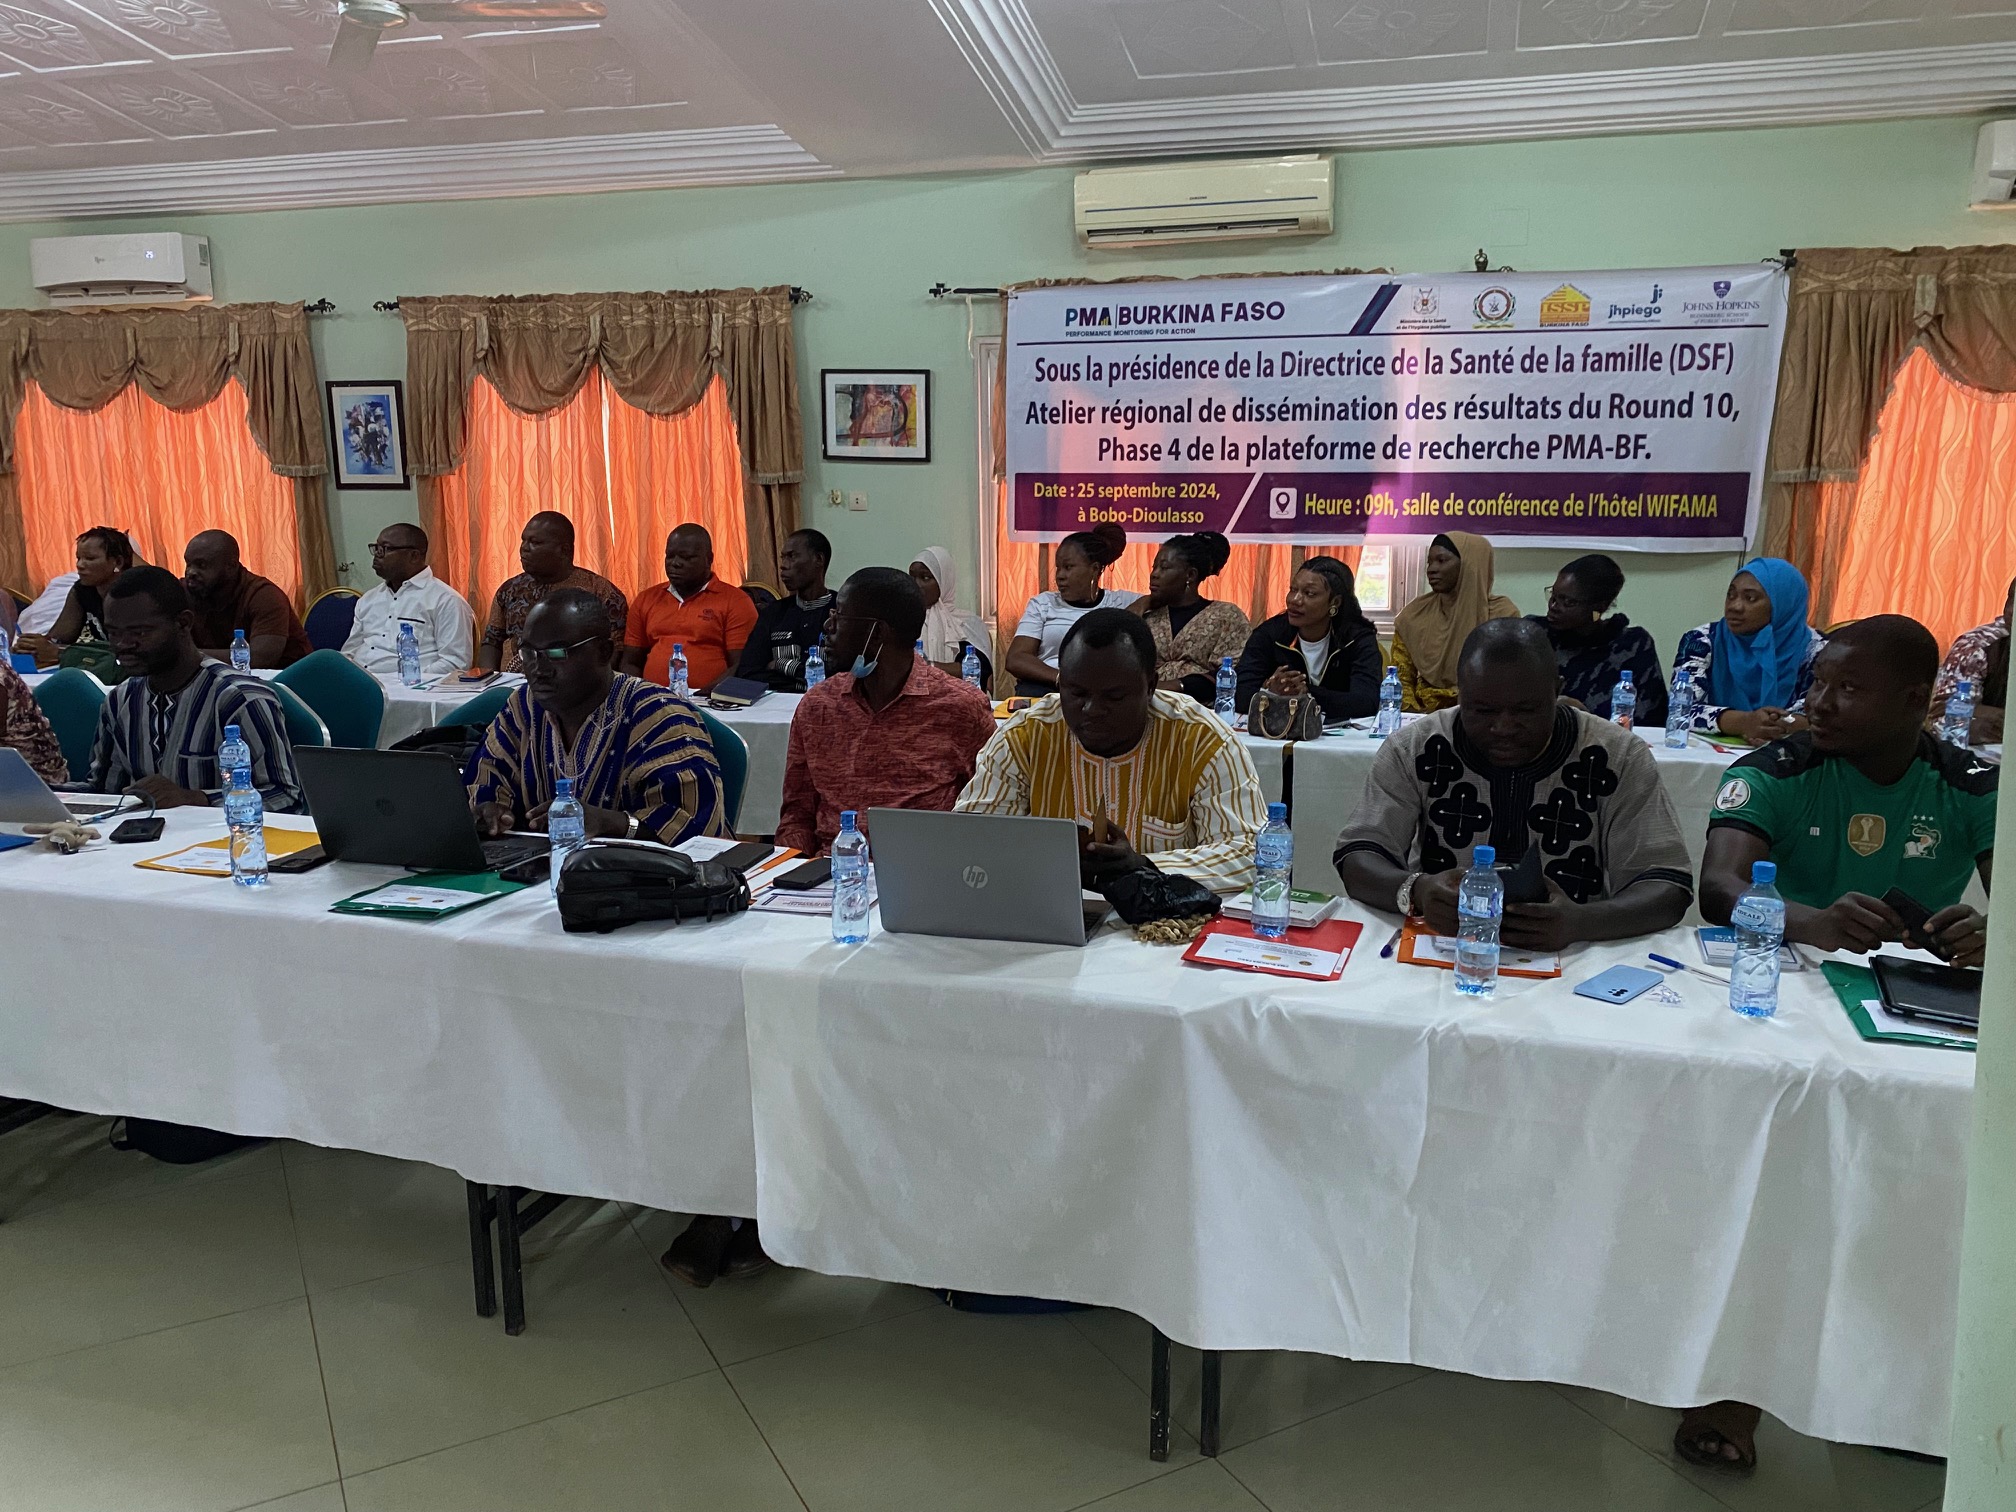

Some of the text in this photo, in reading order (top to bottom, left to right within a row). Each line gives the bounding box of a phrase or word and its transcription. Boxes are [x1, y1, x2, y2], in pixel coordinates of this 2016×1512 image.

[1065, 301, 1285, 326] PMA BURKINA FASO
[1542, 302, 1589, 312] ISSP
[1608, 304, 1662, 319] jhpiego
[1682, 301, 1760, 313] JOHNS HOPKINS
[1035, 342, 1734, 387] Sous la présidence de la Directrice de la Santé de la famille (DSF)
[1025, 391, 1740, 430] Atelier régional de dissémination des résultats du Round 10,
[1099, 434, 1652, 466] Phase 4 de la plateforme de recherche PMA-BF.
[1034, 482, 1067, 498] Date
[1077, 483, 1094, 498] 25
[1098, 482, 1176, 501] septembre
[1180, 483, 1220, 501] 2024,
[1078, 507, 1204, 523] à Bobo-Dioulasso
[1305, 494, 1352, 515] Heure
[1364, 494, 1399, 518] 09h,
[1402, 492, 1440, 517] salle
[1443, 492, 1464, 517] de
[1467, 492, 1559, 517] conférence
[1563, 492, 1584, 517] de
[1647, 494, 1718, 517] WIFAMA
[966, 864, 986, 888] hp
[1737, 909, 1761, 920] IDEALE
